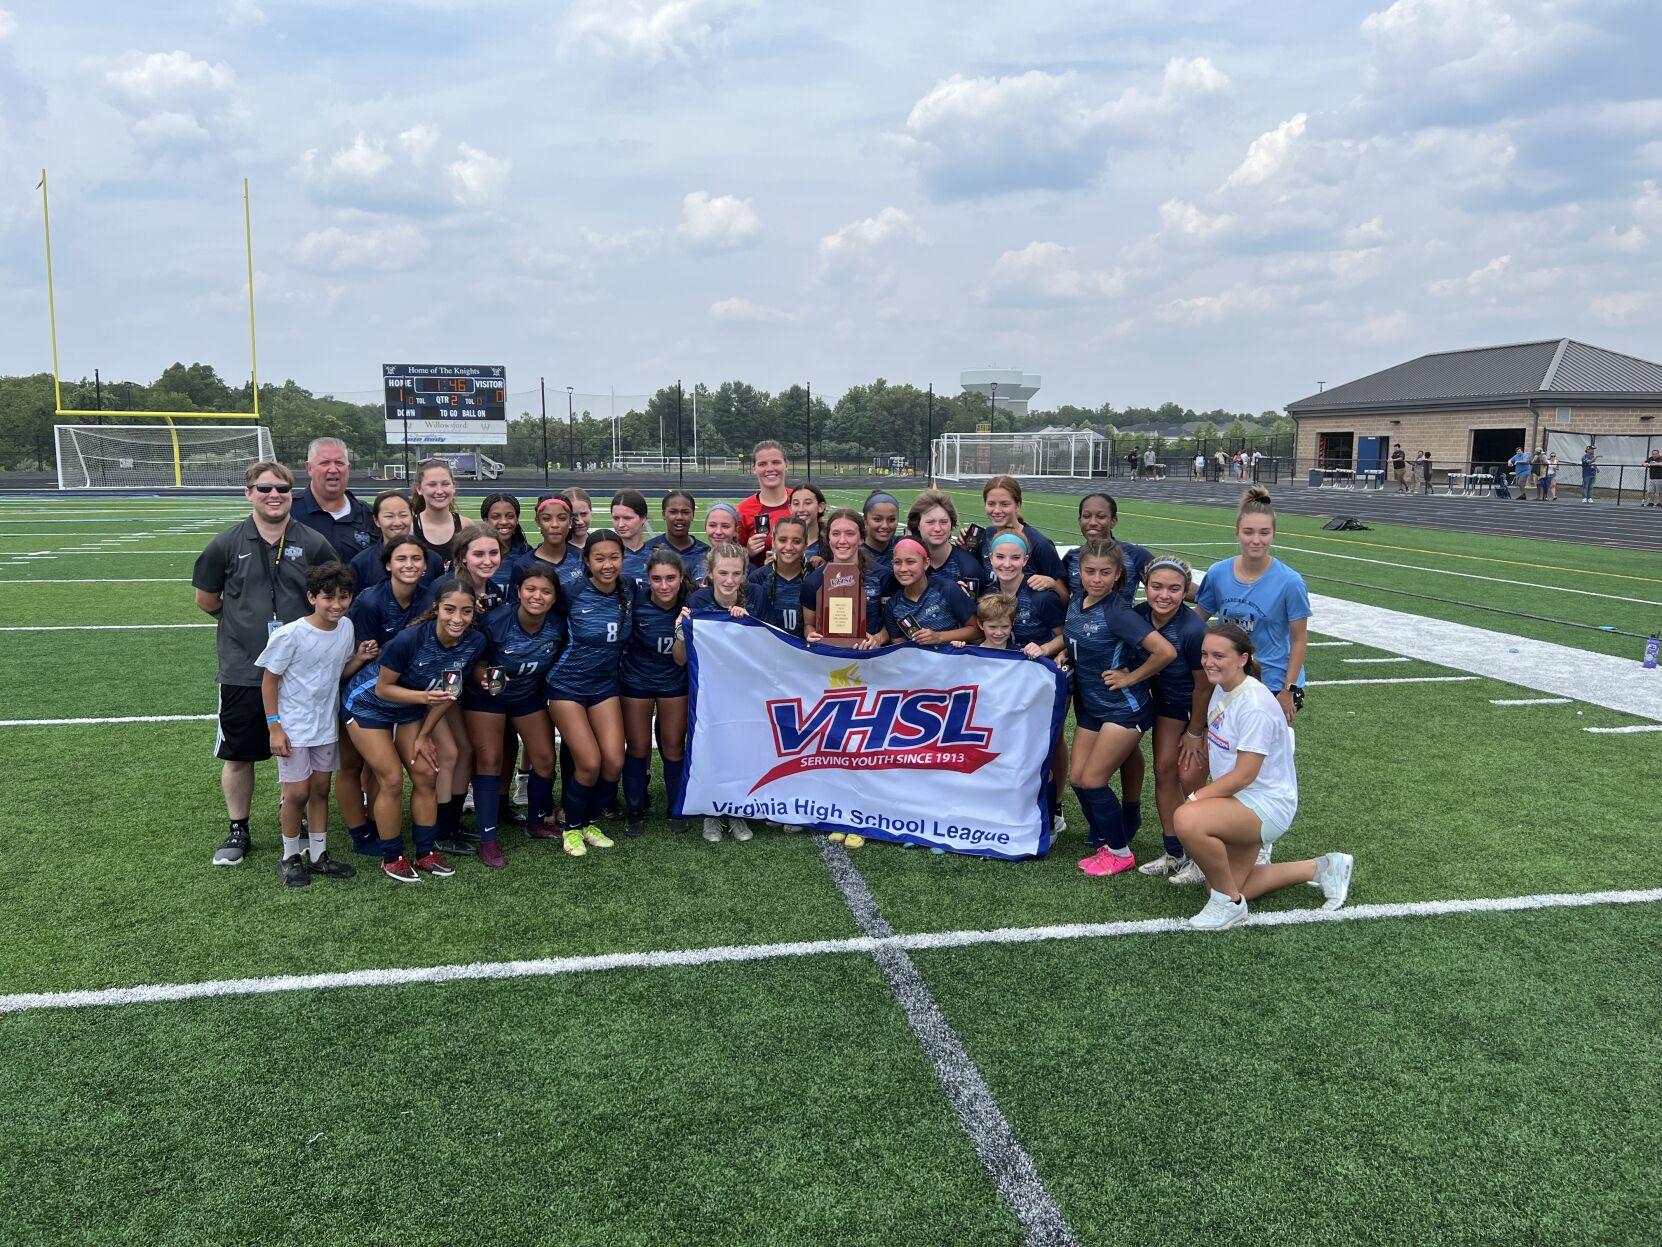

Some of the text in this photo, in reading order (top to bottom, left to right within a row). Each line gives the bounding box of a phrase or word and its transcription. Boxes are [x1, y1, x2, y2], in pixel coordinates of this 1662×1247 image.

[408, 366, 429, 374] Home
[430, 366, 438, 374] of
[454, 367, 480, 376] Knights
[475, 380, 504, 388] VISITOR
[415, 397, 426, 405] TOL
[436, 395, 449, 405] QTR
[440, 409, 458, 418] TO GO
[462, 409, 486, 418] BALL ON
[782, 608, 797, 631] 10
[606, 622, 618, 643] 8
[657, 636, 674, 655] 12
[518, 661, 539, 676] 17
[767, 685, 993, 757] VHSL
[800, 752, 965, 767] SERVING YOUTH SINCE 1913
[712, 798, 1010, 845] Virginia High School League
